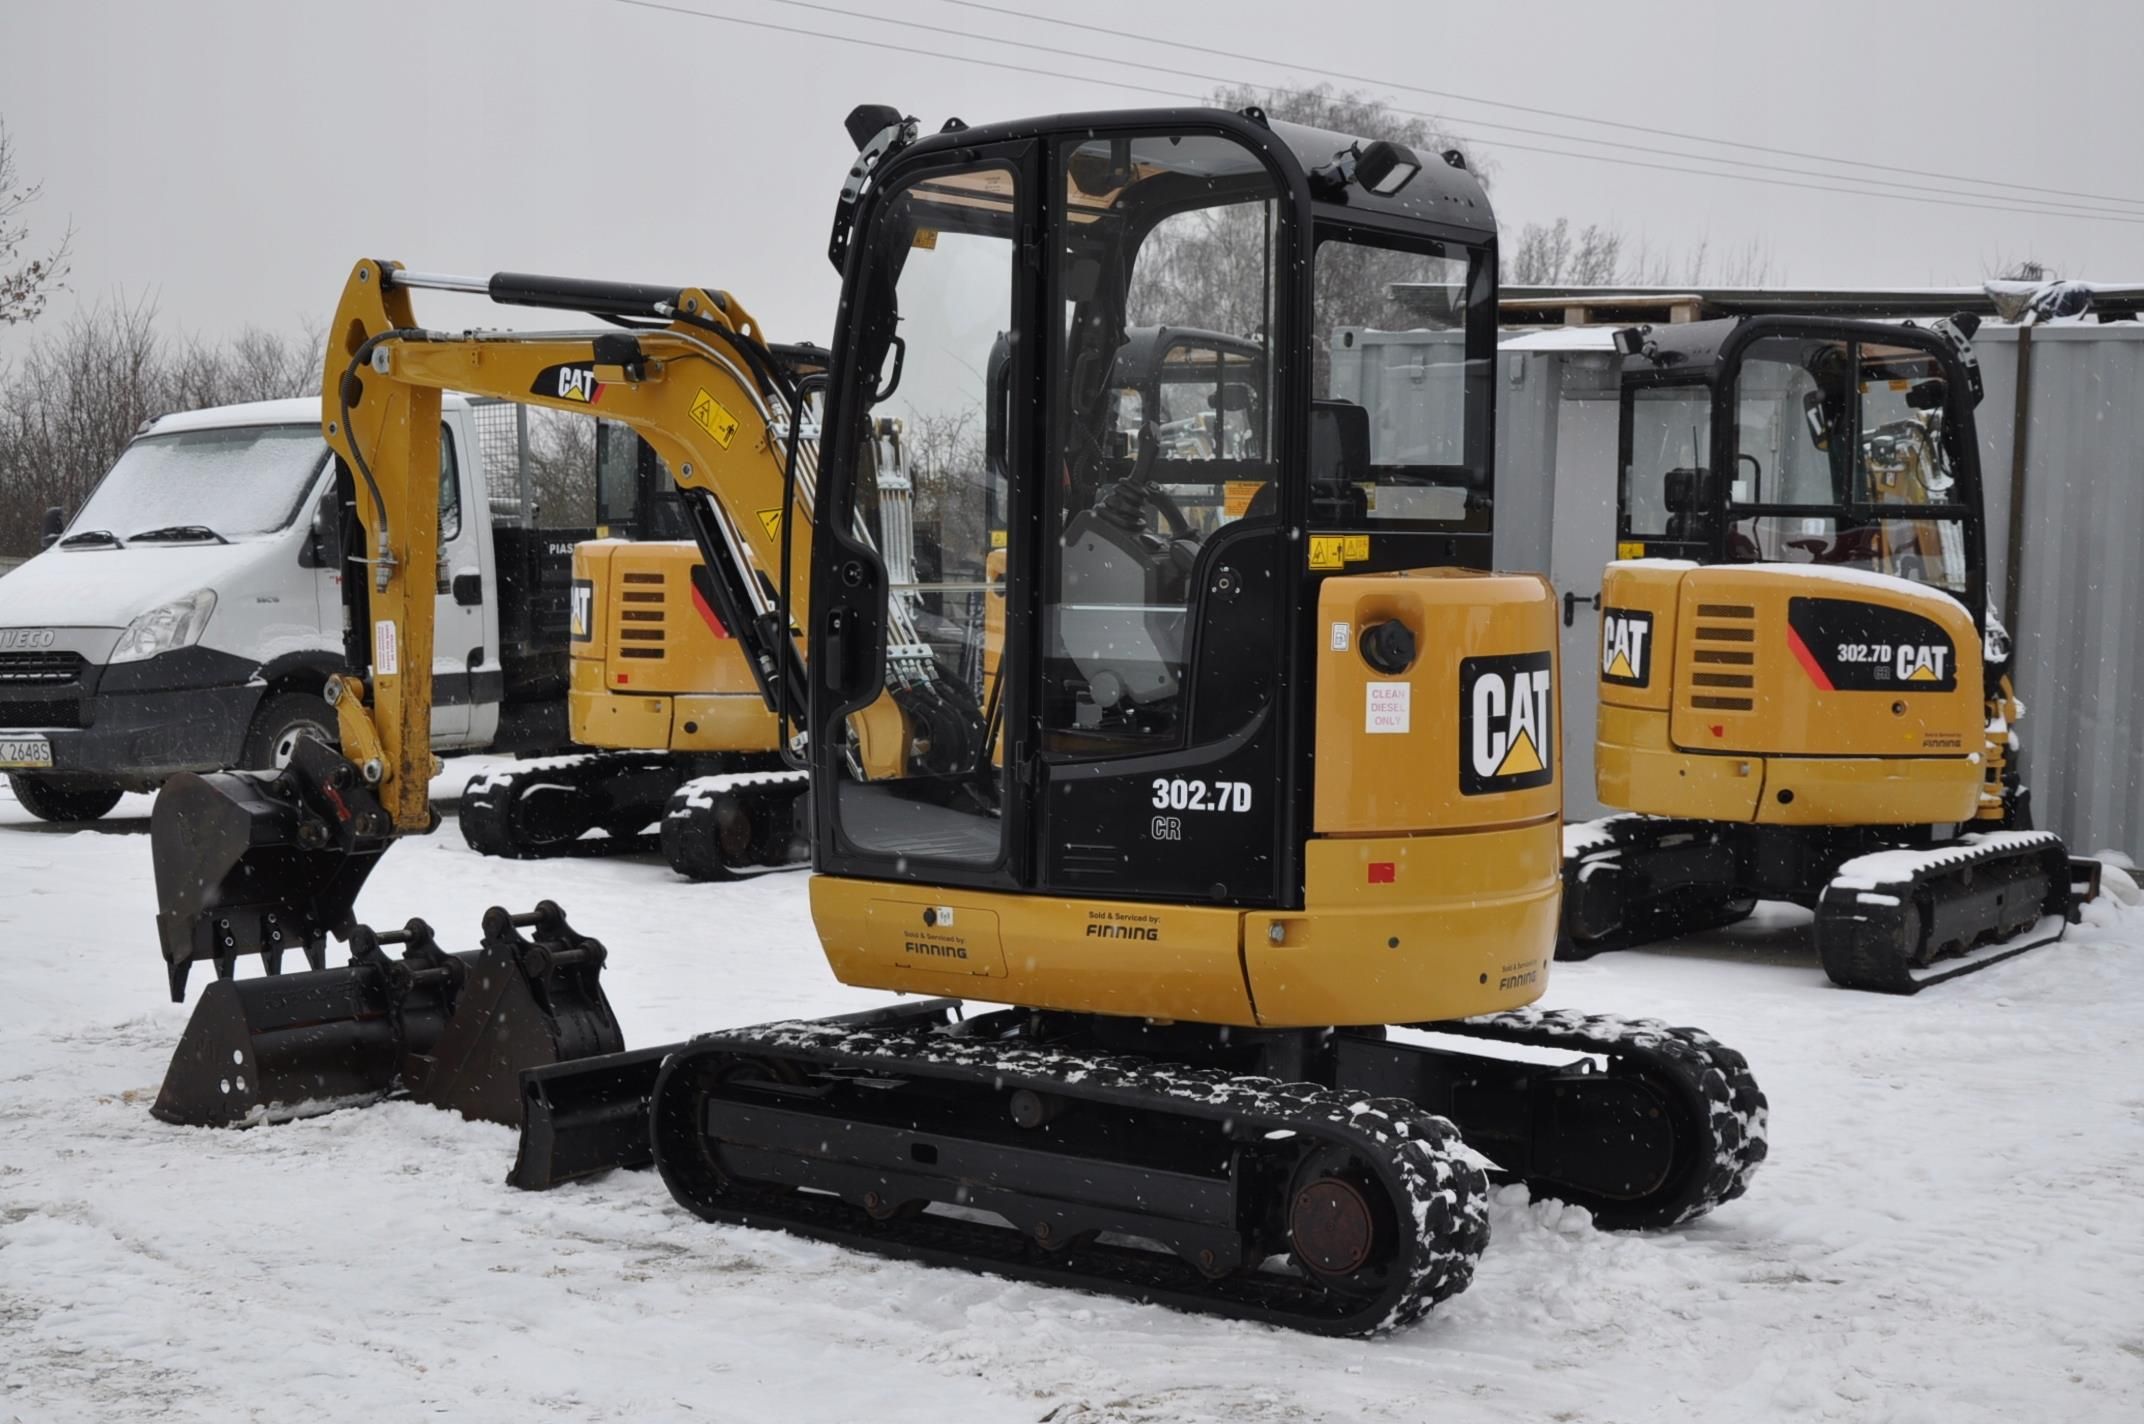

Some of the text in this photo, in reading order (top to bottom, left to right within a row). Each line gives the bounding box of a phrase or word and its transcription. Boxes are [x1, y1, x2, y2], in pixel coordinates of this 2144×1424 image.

[558, 366, 594, 402] CAT
[571, 587, 591, 635] AT
[1603, 615, 1648, 678] CAT
[1837, 643, 1948, 680] 302.7D CAT
[1372, 689, 1406, 699] CLEAN
[1371, 703, 1406, 713] DIESEL
[1375, 716, 1401, 726] ONLY
[1473, 671, 1550, 777] CAT
[1152, 778, 1252, 812] 302.7D
[1151, 816, 1181, 840] CR
[1088, 911, 1106, 920] Sold
[1107, 912, 1113, 920] &
[1115, 912, 1147, 922] Serviced
[1086, 924, 1159, 941] FINNING
[905, 941, 967, 960] FINNING
[1499, 970, 1536, 991] FINNING
